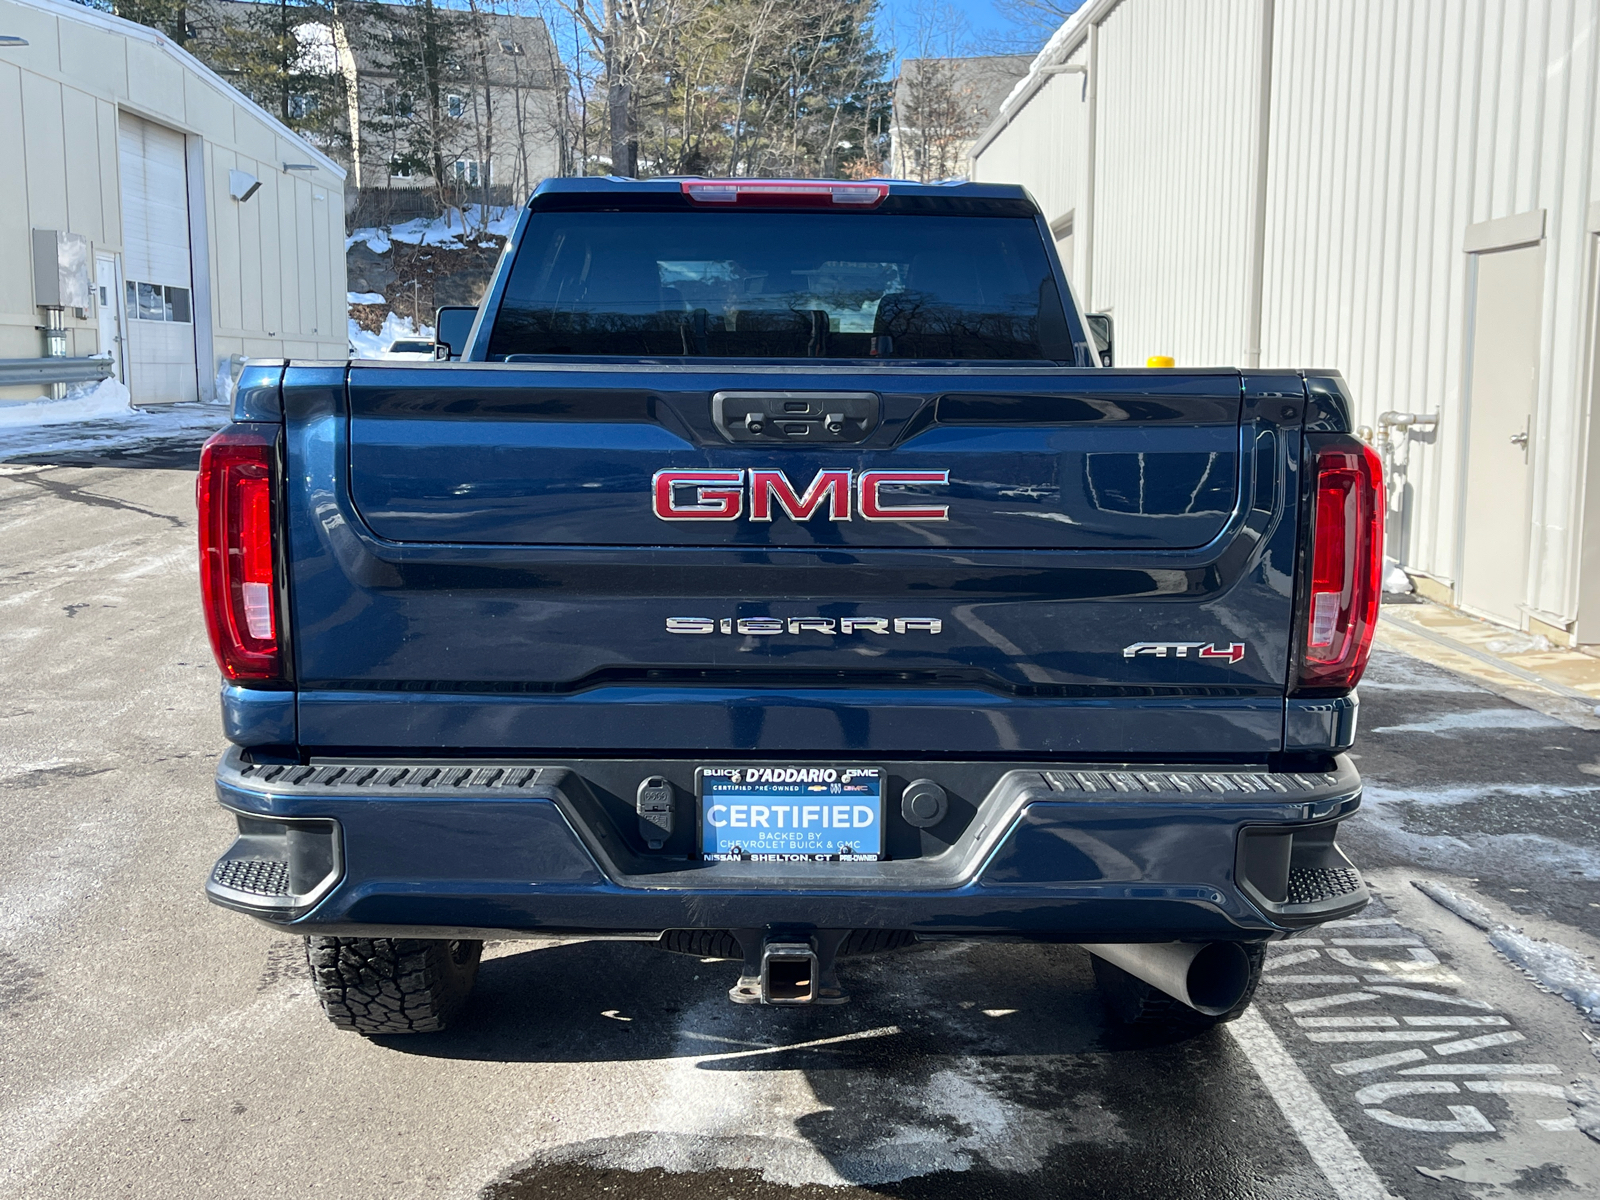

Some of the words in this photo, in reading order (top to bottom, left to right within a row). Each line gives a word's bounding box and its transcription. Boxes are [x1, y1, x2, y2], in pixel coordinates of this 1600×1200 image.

[652, 467, 950, 522] GMC
[666, 616, 943, 635] SIERRA
[1123, 642, 1246, 664] AT4
[745, 768, 838, 783] D'ADDARIO
[845, 769, 879, 777] GMC
[706, 804, 874, 828] CERTIFIED
[758, 832, 804, 840] BACKED
[807, 832, 822, 840] BY
[719, 840, 786, 849] CHEVROLET
[789, 840, 823, 849] BUICK
[826, 840, 834, 849] &
[836, 840, 861, 849] GMC
[703, 854, 741, 862] NISSAN
[750, 854, 812, 862] SHELTON,
[815, 854, 833, 862] CT
